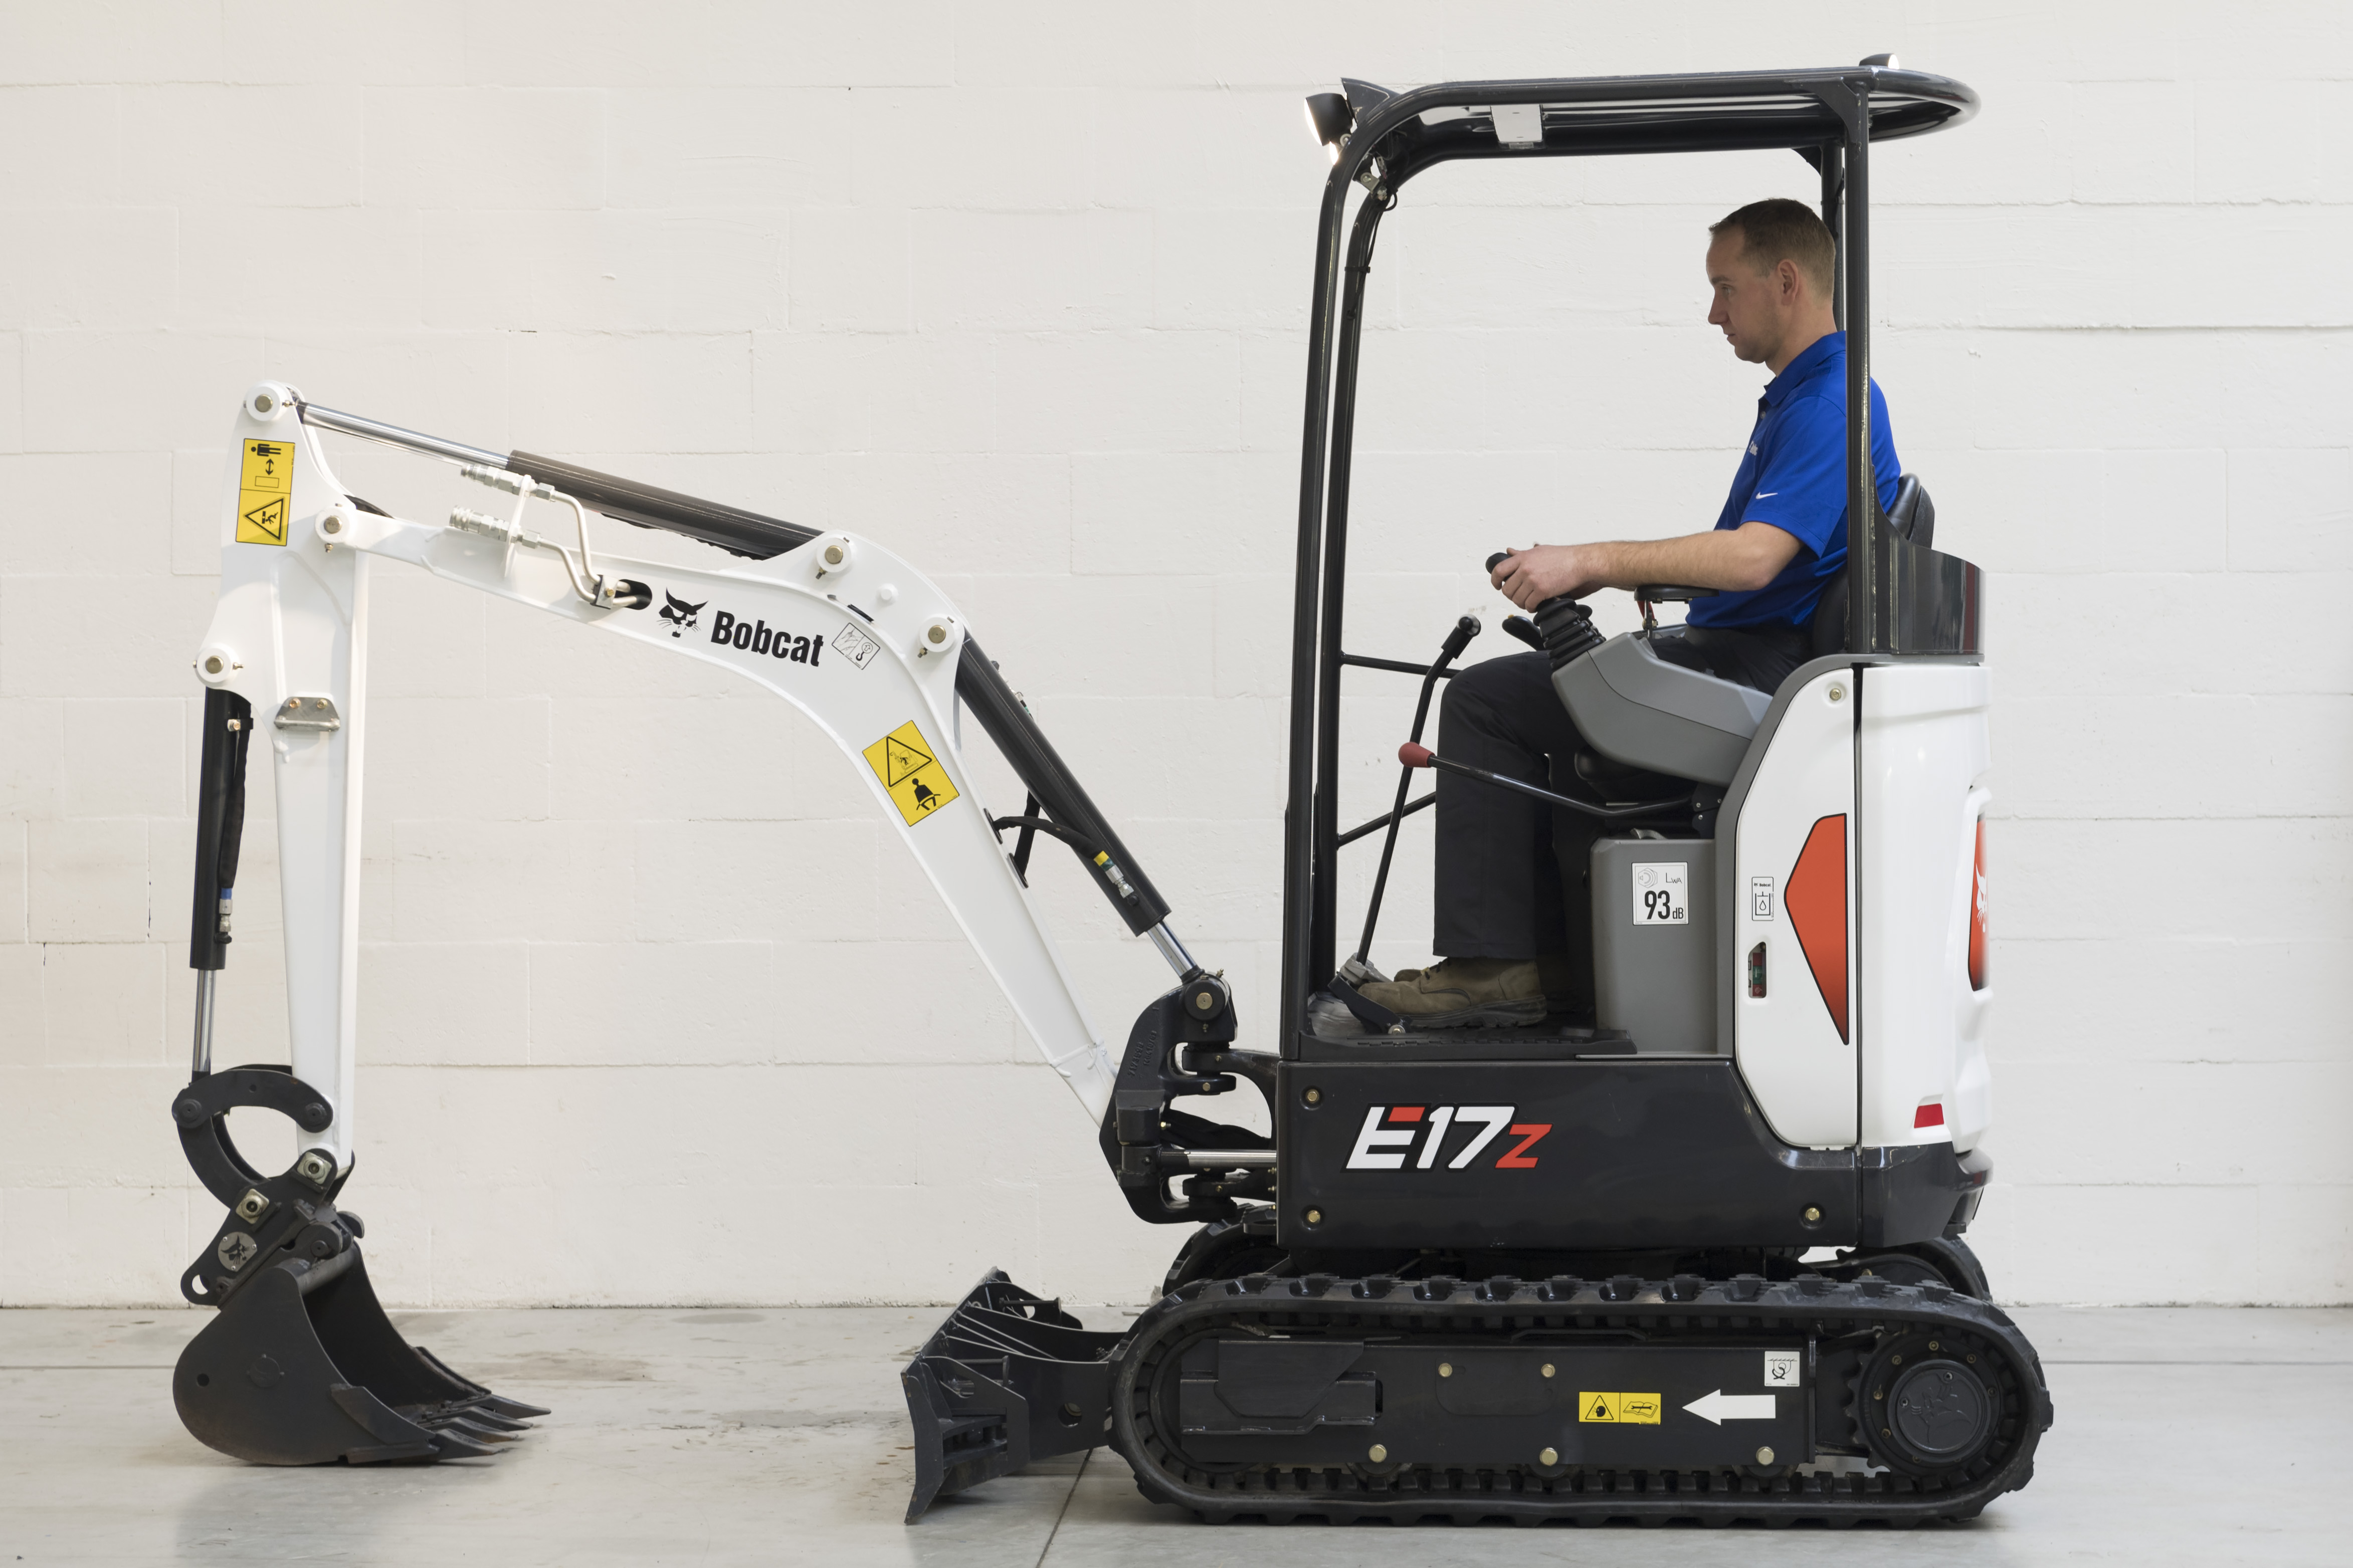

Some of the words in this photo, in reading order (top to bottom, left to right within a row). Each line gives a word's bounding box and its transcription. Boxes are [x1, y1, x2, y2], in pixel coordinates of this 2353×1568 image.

[711, 610, 824, 667] Bobcat
[1644, 890, 1670, 920] 93
[1672, 907, 1684, 920] dB
